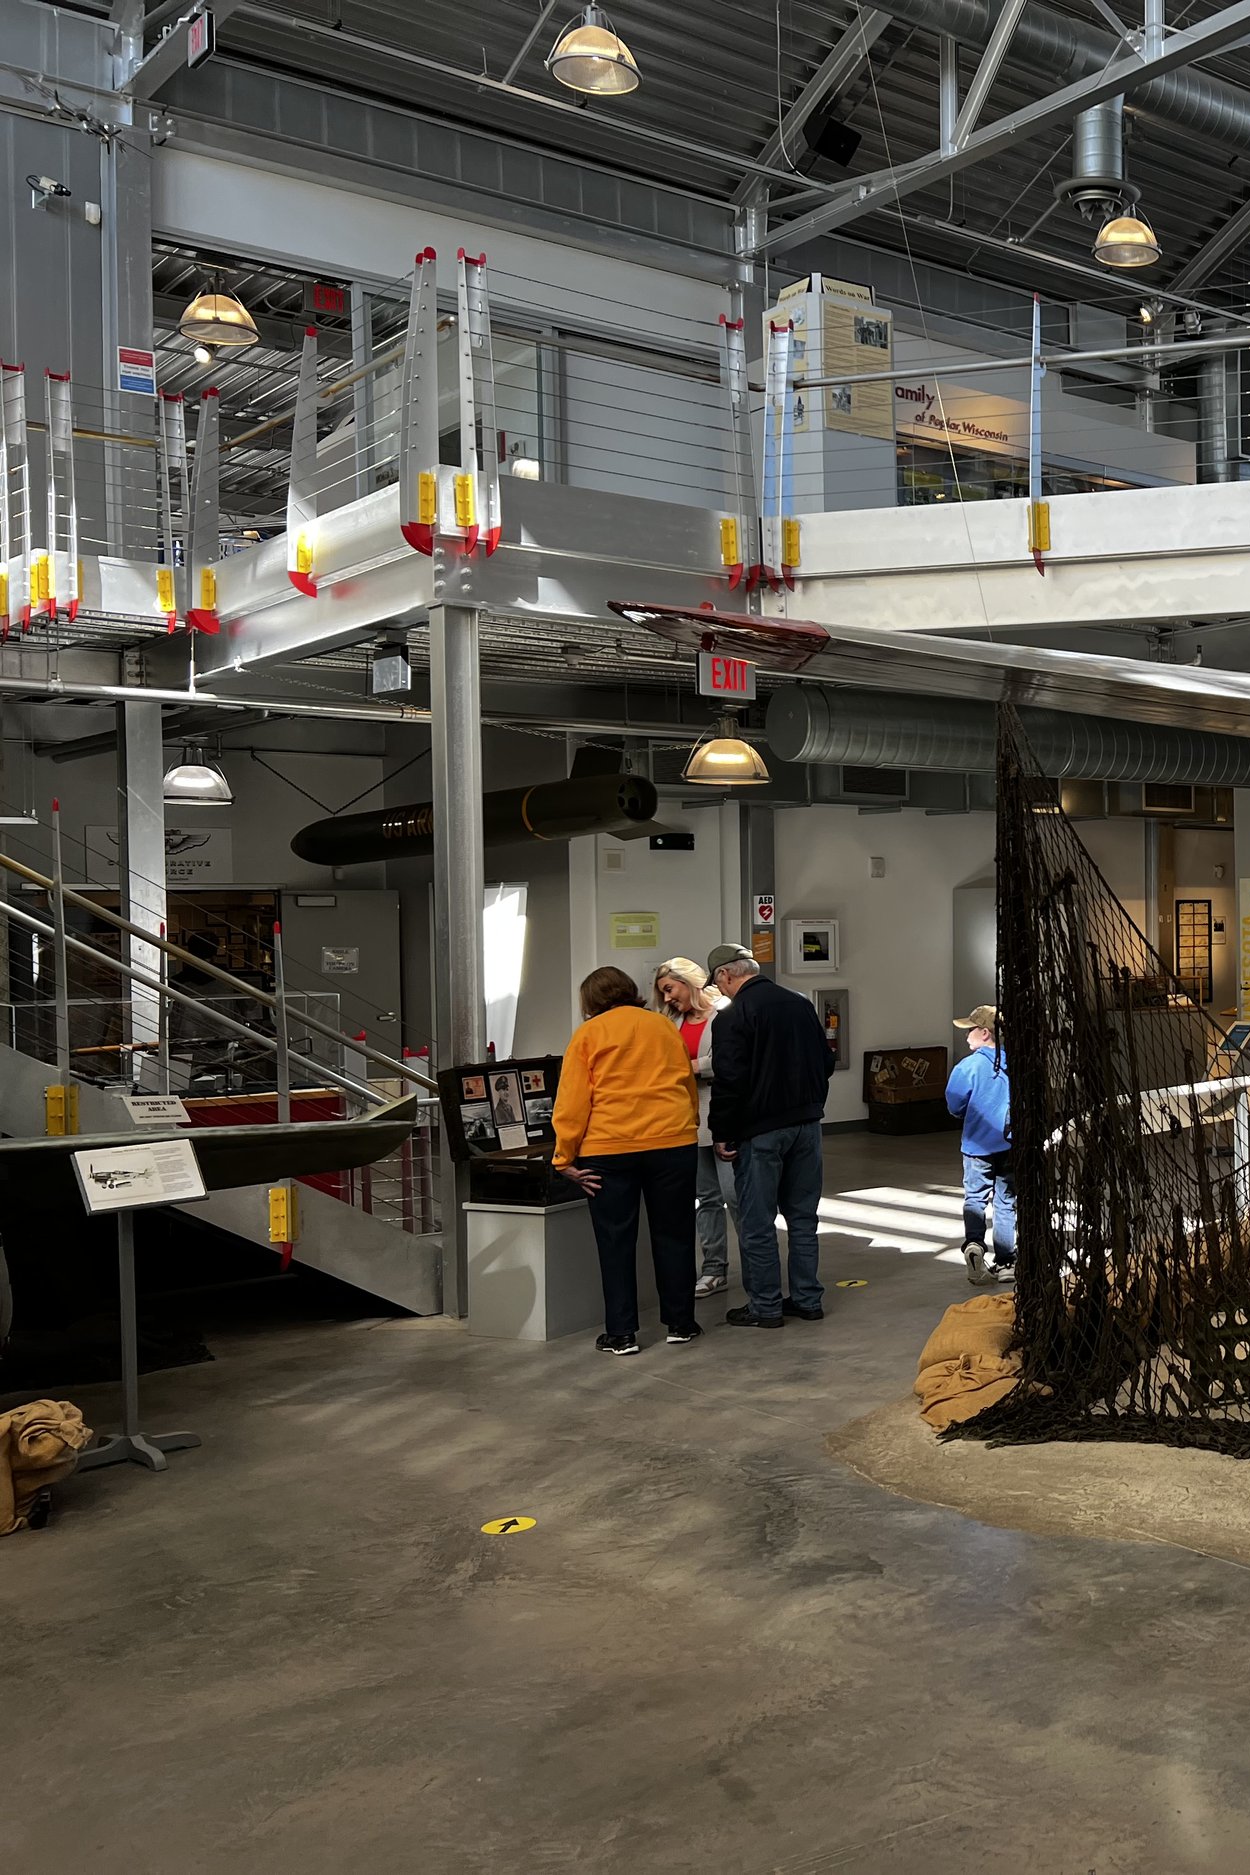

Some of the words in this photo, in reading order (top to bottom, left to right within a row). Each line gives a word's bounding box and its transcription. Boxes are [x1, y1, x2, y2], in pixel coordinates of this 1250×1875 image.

[313, 284, 345, 314] EXIT
[825, 285, 846, 296] Words
[856, 292, 870, 301] War
[895, 384, 935, 410] amily
[915, 411, 925, 423] of
[928, 414, 961, 434] Poplar,
[961, 421, 1008, 442] Wisconsin
[712, 657, 747, 692] EXIT
[758, 896, 773, 904] AED
